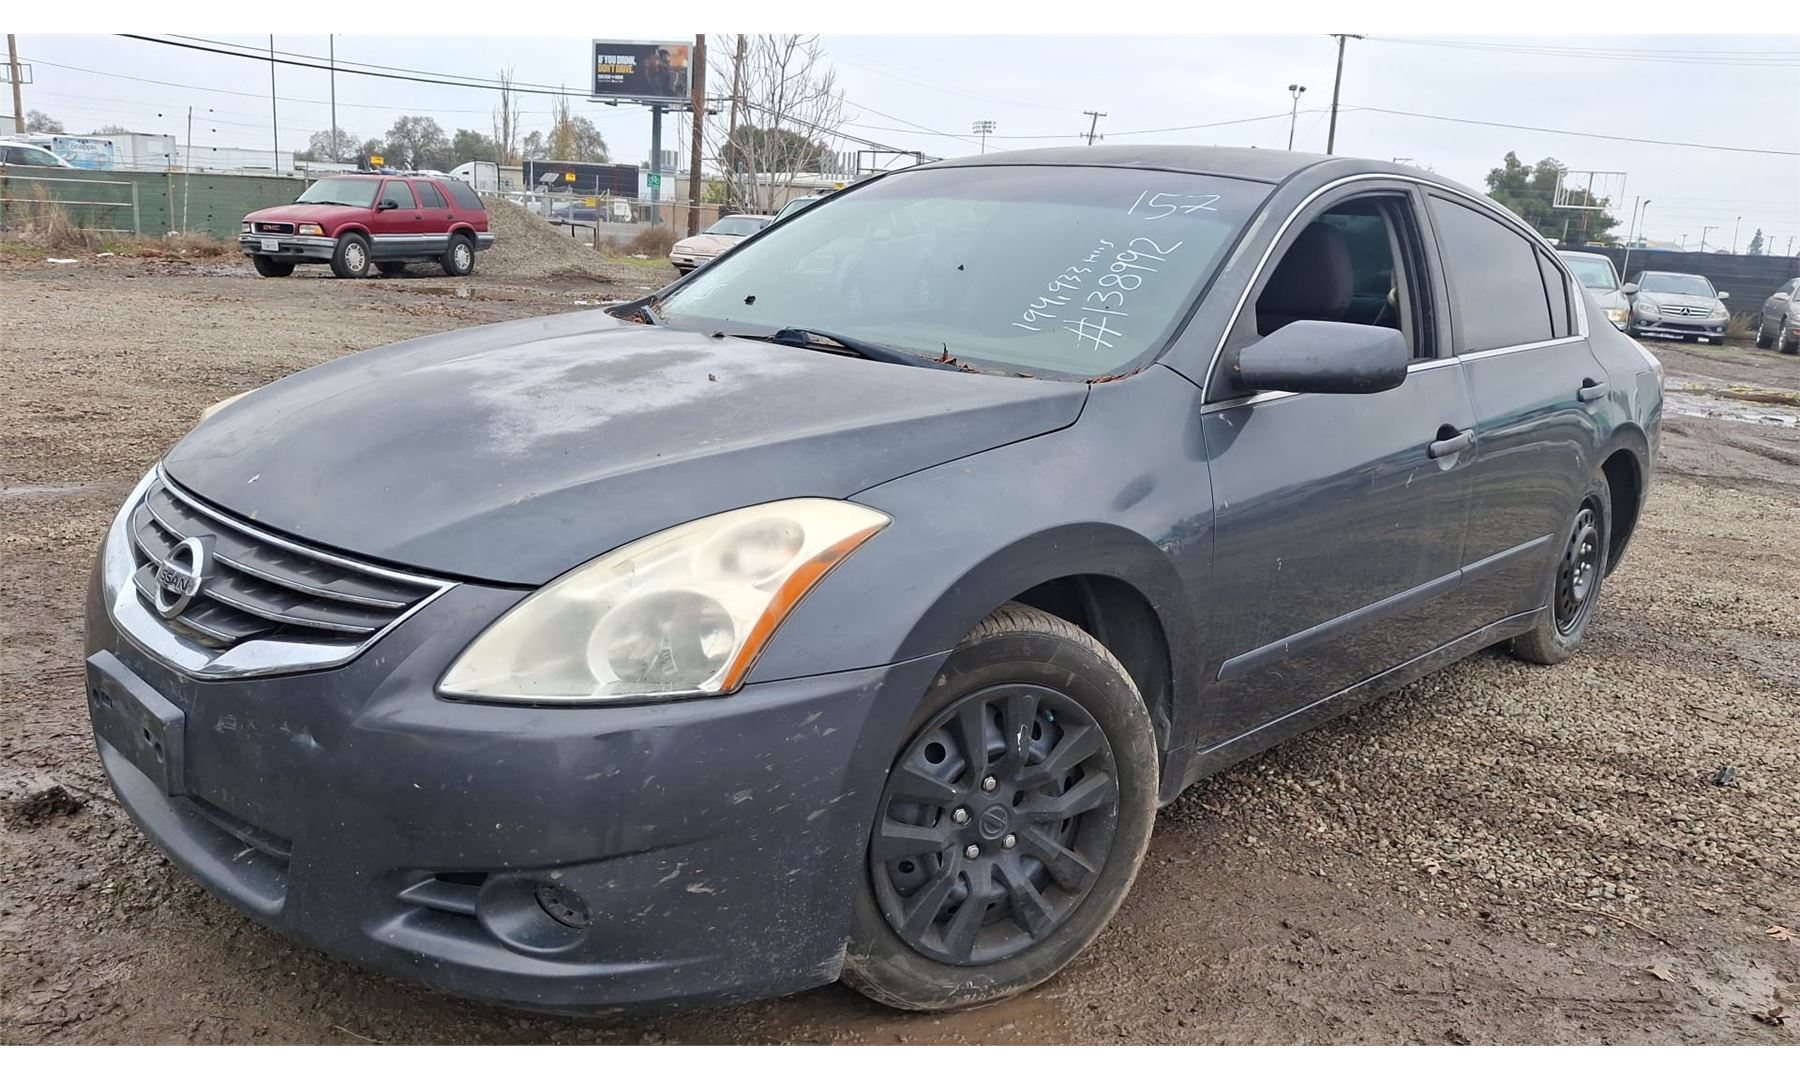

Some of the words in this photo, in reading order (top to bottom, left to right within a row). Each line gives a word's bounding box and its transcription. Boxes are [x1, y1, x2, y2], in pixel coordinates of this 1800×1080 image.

[1128, 190, 1221, 220] 157
[1012, 266, 1092, 331] 194,933
[1063, 237, 1184, 351] #138992
